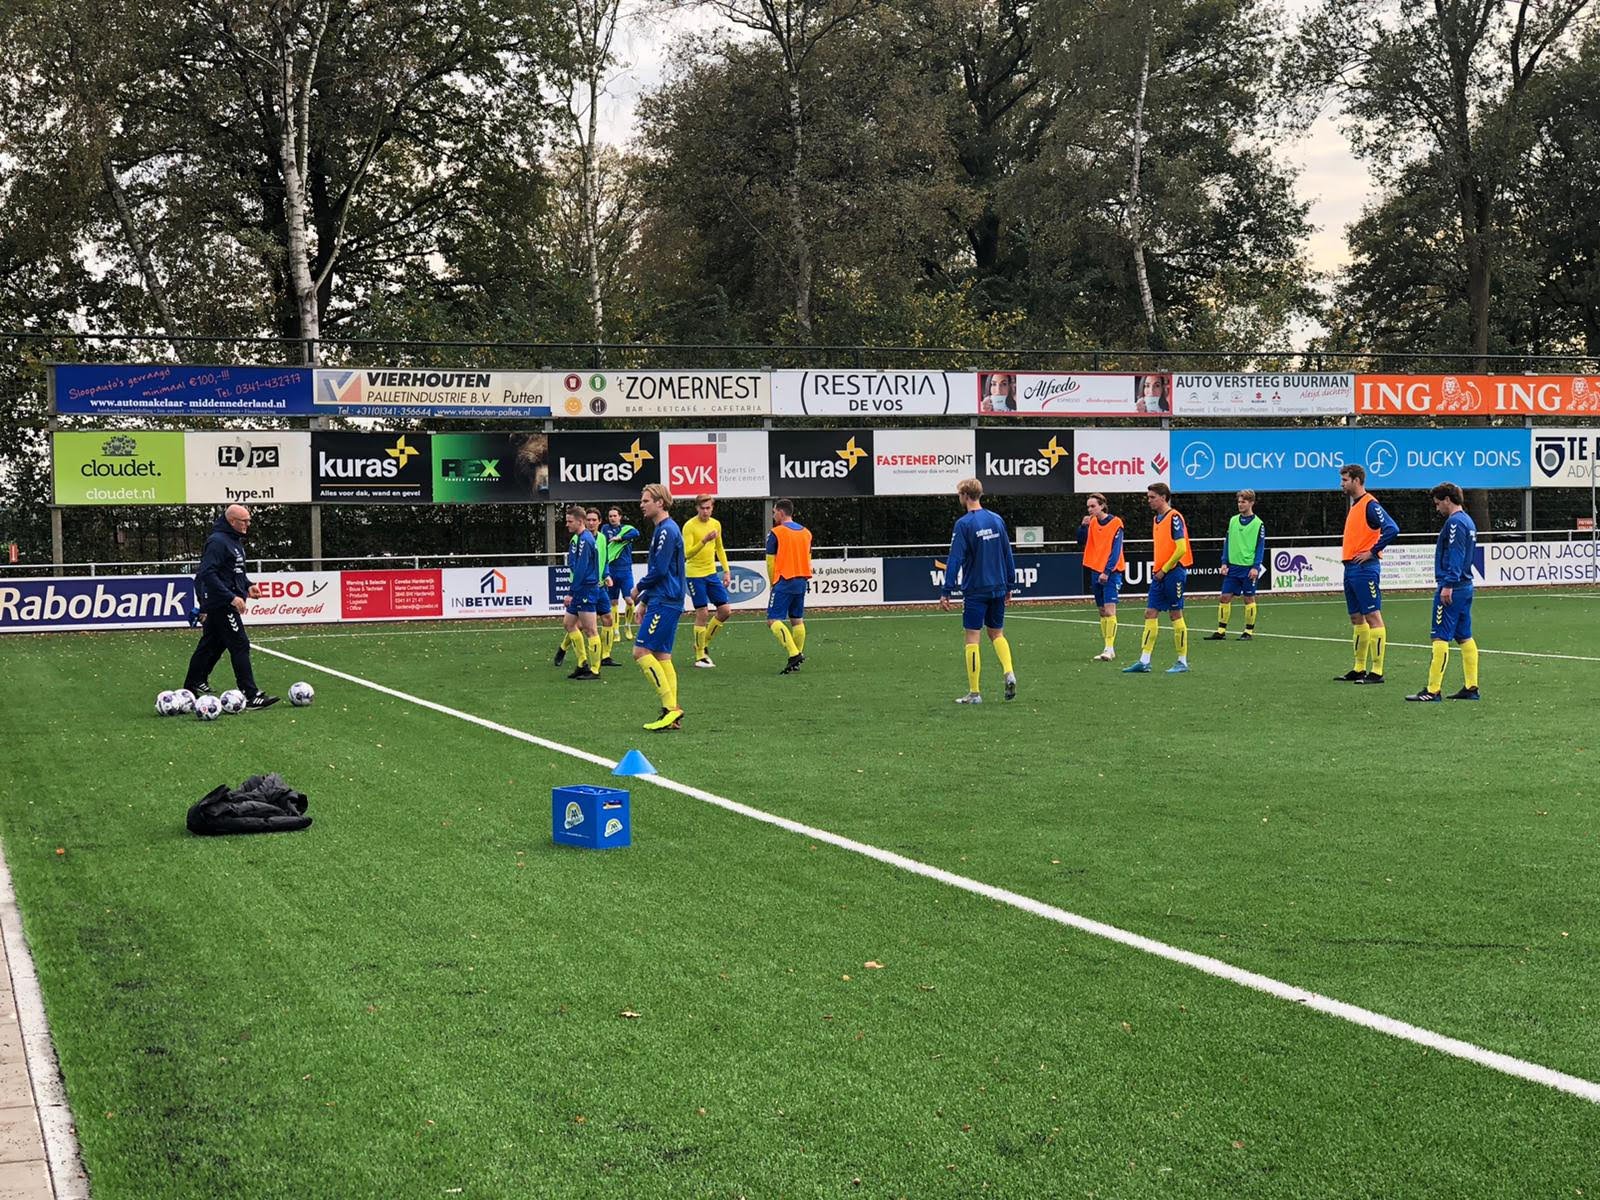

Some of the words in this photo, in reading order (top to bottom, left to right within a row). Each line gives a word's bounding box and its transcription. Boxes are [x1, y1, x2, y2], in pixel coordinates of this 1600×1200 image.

[69, 377, 125, 399] Sloopauto's
[128, 367, 171, 388] gevraagd
[143, 381, 186, 397] minimaal
[367, 372, 491, 388] VIERHOUTEN
[616, 376, 624, 392] 't
[625, 376, 761, 399] ZOMERNEST
[814, 375, 935, 395] RESTARIA
[1024, 377, 1077, 400] Alfredo
[1176, 376, 1212, 388] AUTO
[1215, 376, 1280, 388] VERSTEEG
[1283, 376, 1349, 388] BUURMAN
[189, 399, 287, 408] middennederland.nl
[367, 391, 467, 403] PALLETINDUSTRIE
[503, 390, 543, 404] Putten
[849, 400, 868, 411] DE
[872, 400, 903, 411] VOS
[1360, 383, 1432, 411] ING
[1495, 383, 1562, 411] ING
[1567, 437, 1587, 460] TE
[319, 451, 398, 478] kuras
[779, 454, 848, 479] kuras
[876, 454, 974, 466] FASTENERPOINT
[985, 452, 1049, 476] kuras
[1077, 453, 1145, 475] Eternit
[1224, 452, 1286, 469] DUCKY
[1294, 451, 1345, 468] DONS
[1407, 451, 1465, 467] DUCKY
[1474, 450, 1521, 467] DONS
[81, 459, 162, 477] cloudet.
[441, 459, 501, 478] REX
[559, 457, 633, 482] kuras
[670, 465, 715, 485] SVK
[86, 487, 156, 500] cloudet.nl
[225, 487, 274, 502] hype.nl
[320, 490, 338, 498] Alles
[356, 490, 369, 498] dak,
[372, 490, 390, 498] wand
[402, 490, 421, 499] gevel
[1491, 545, 1551, 560] DOORN
[825, 566, 877, 576] glasbewassing
[258, 580, 304, 598] EBO
[728, 575, 762, 593] der
[1273, 575, 1297, 588] ABP
[0, 582, 187, 621] Rabobank
[251, 603, 278, 615] Goed
[278, 602, 325, 617] Geregeld
[451, 596, 533, 608] INBETWEEN
